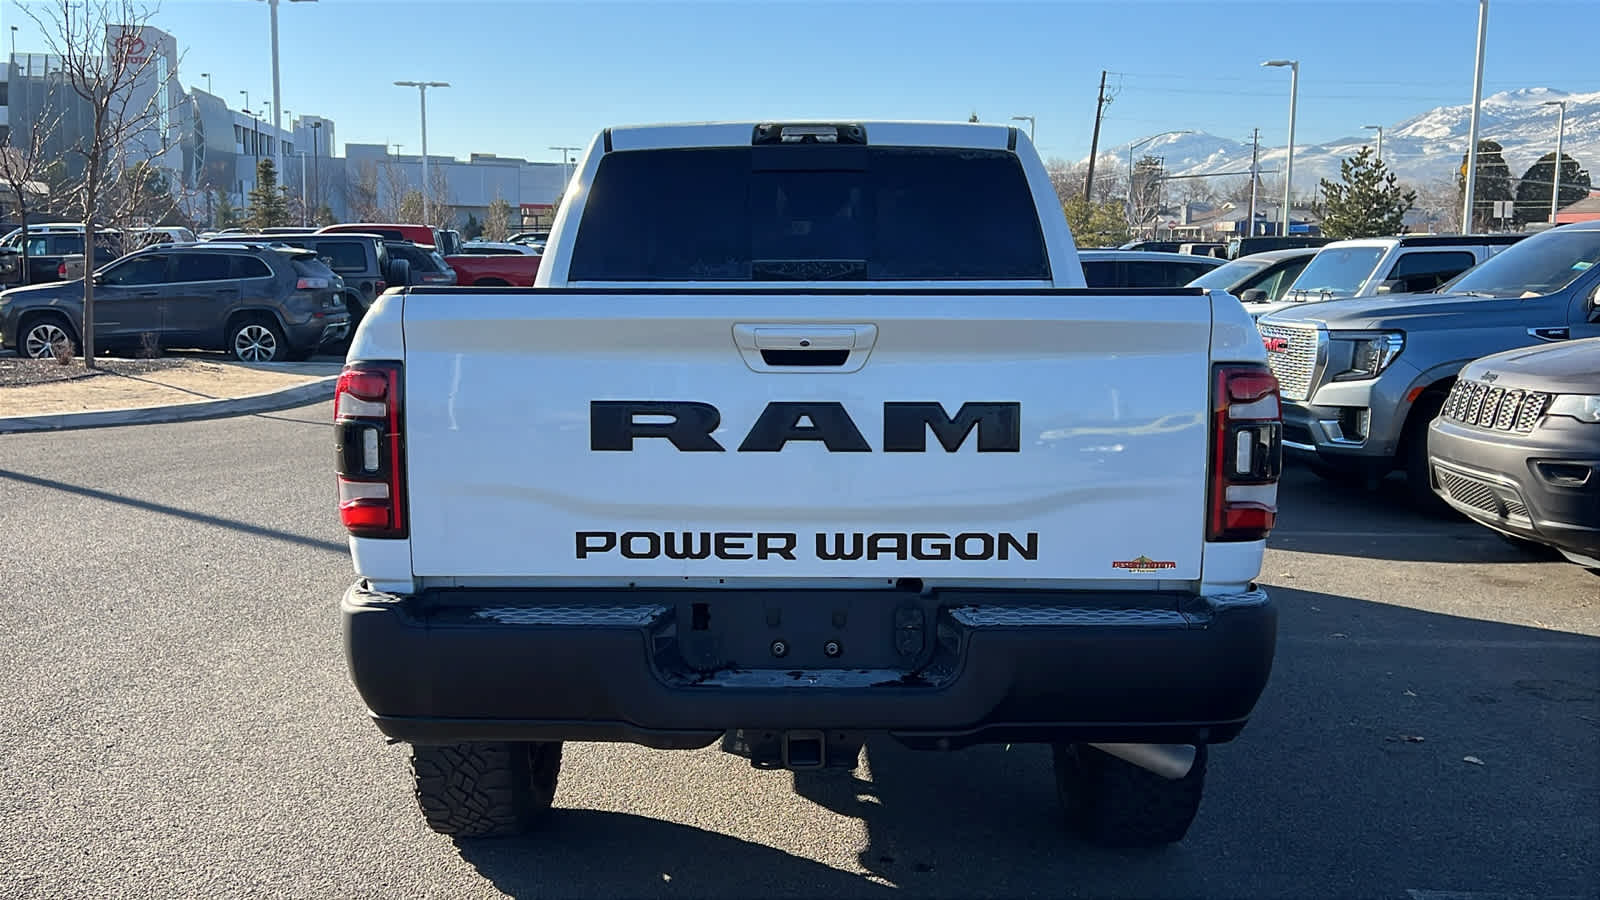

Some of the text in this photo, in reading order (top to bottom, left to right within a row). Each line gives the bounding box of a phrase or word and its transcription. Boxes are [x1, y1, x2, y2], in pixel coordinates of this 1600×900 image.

[590, 400, 1021, 453] RAM
[575, 531, 1039, 561] POWER WAGON
